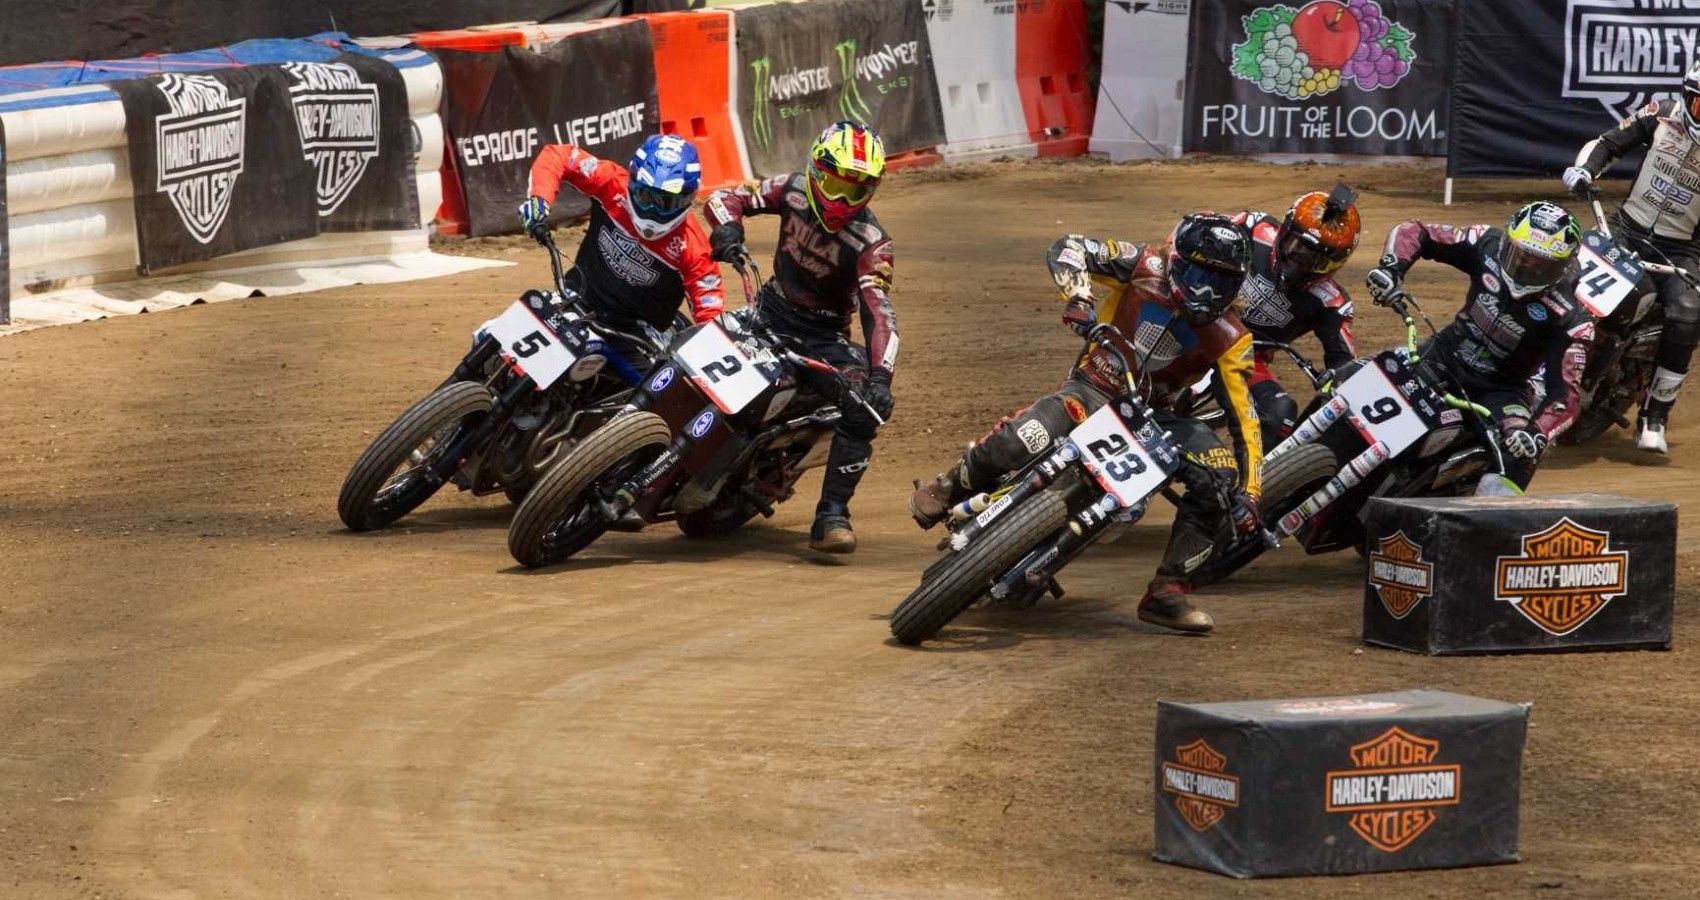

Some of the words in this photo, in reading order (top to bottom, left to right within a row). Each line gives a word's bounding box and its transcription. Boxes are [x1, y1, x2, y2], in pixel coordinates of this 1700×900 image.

[768, 66, 832, 101] MONSTER
[1201, 103, 1302, 138] FRUIT
[1300, 122, 1332, 139] THE
[1304, 106, 1329, 122] OF
[456, 127, 539, 167] EPROOF
[179, 172, 229, 225] CYCLES
[1580, 259, 1619, 299] 14
[511, 329, 552, 359] 5
[700, 354, 743, 384] 2
[1361, 396, 1402, 425] 9
[1086, 433, 1148, 482] 23
[1536, 530, 1595, 558] MOTOR
[1505, 562, 1620, 589] HARLEY-DAVIDSON
[1531, 594, 1592, 624] CYCLES
[1361, 733, 1428, 767] MOTOR
[1331, 771, 1456, 806] HARLEY-DAVIDSON
[1359, 809, 1426, 844] CYCLES
